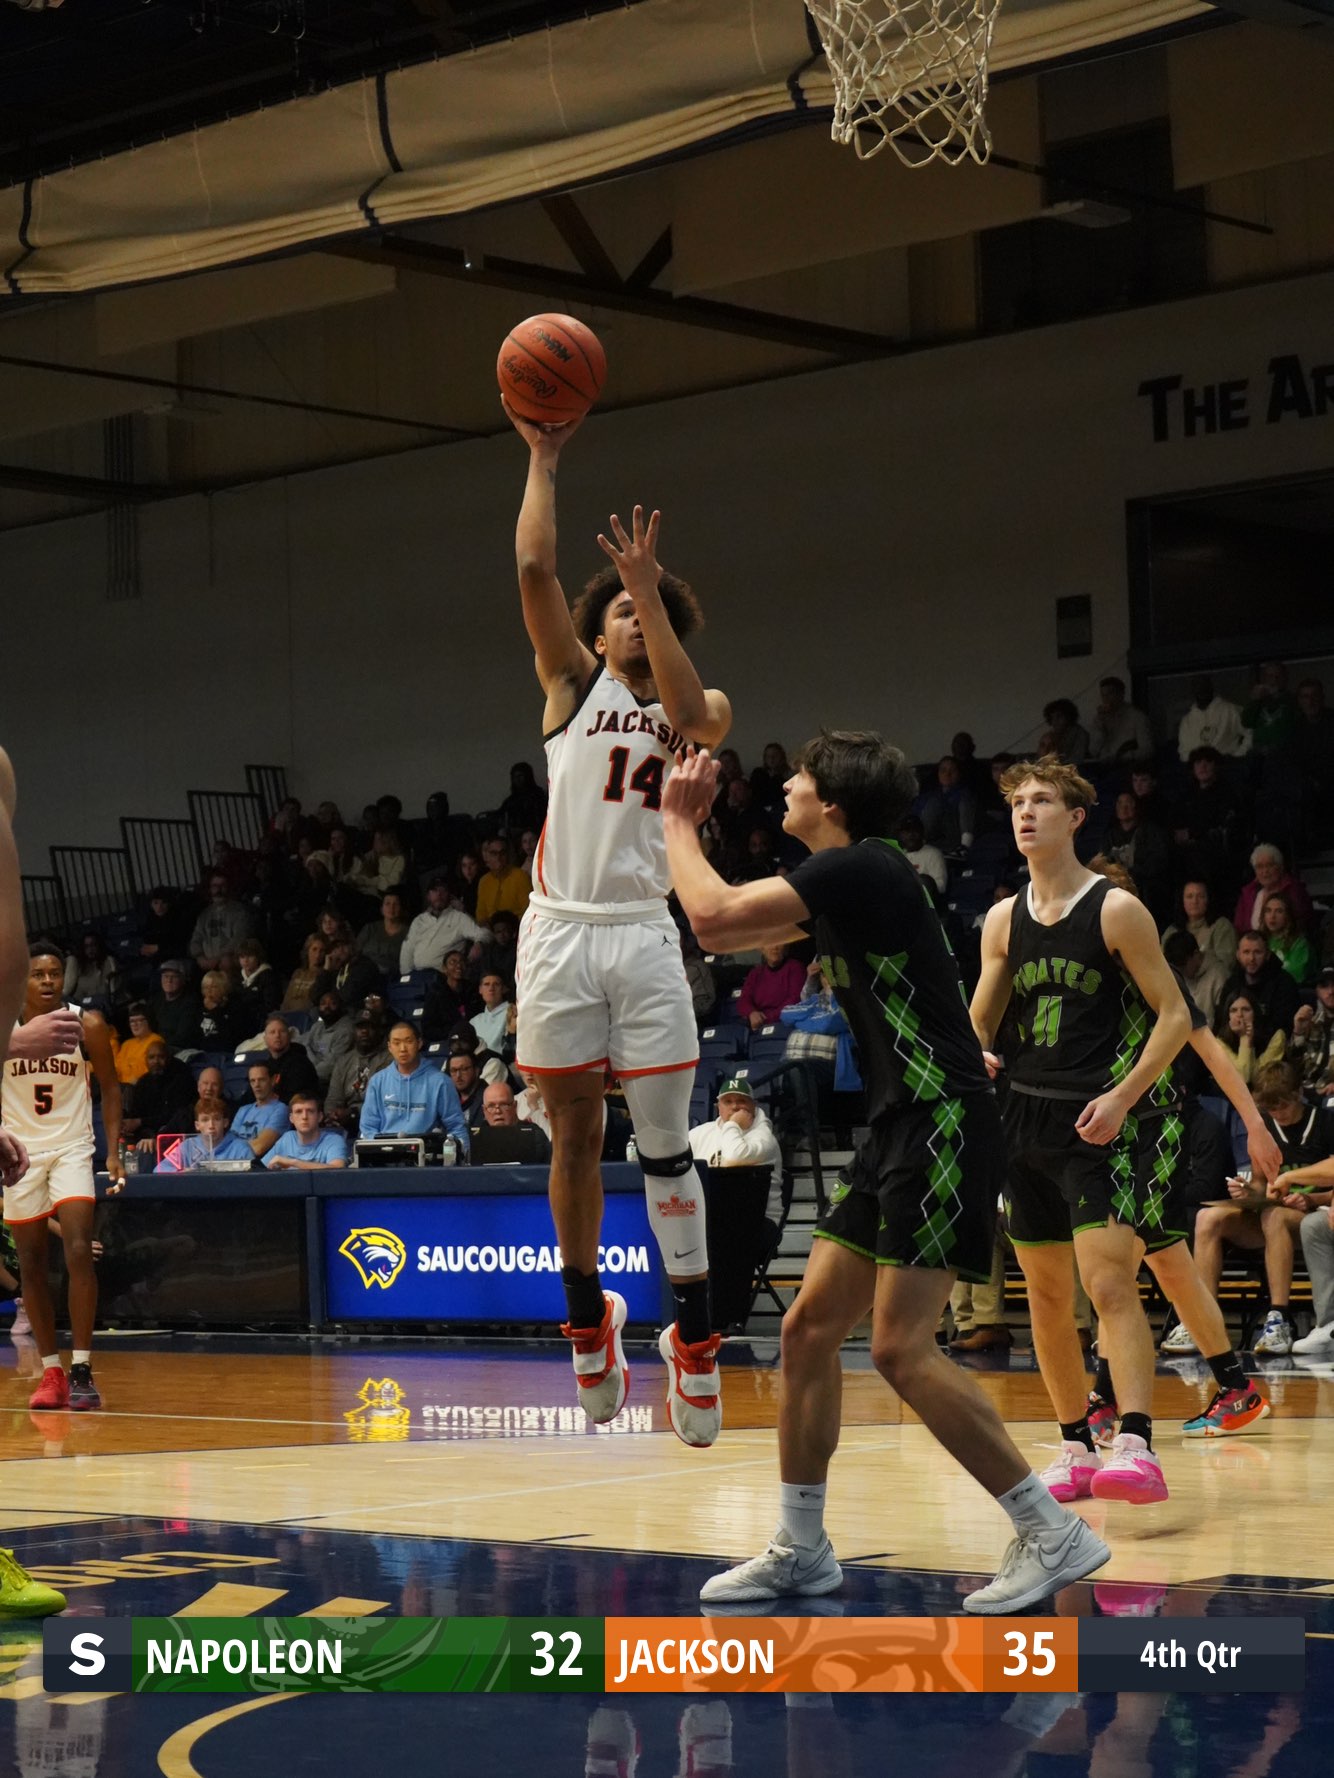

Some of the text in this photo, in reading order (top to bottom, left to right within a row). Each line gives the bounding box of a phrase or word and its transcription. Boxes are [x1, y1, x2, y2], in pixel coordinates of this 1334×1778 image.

[1137, 373, 1250, 442] THE
[602, 744, 667, 813] 14
[1031, 995, 1063, 1048] 11
[12, 1058, 79, 1077] JACKSON
[730, 1080, 739, 1089] N
[33, 1083, 54, 1116] 5
